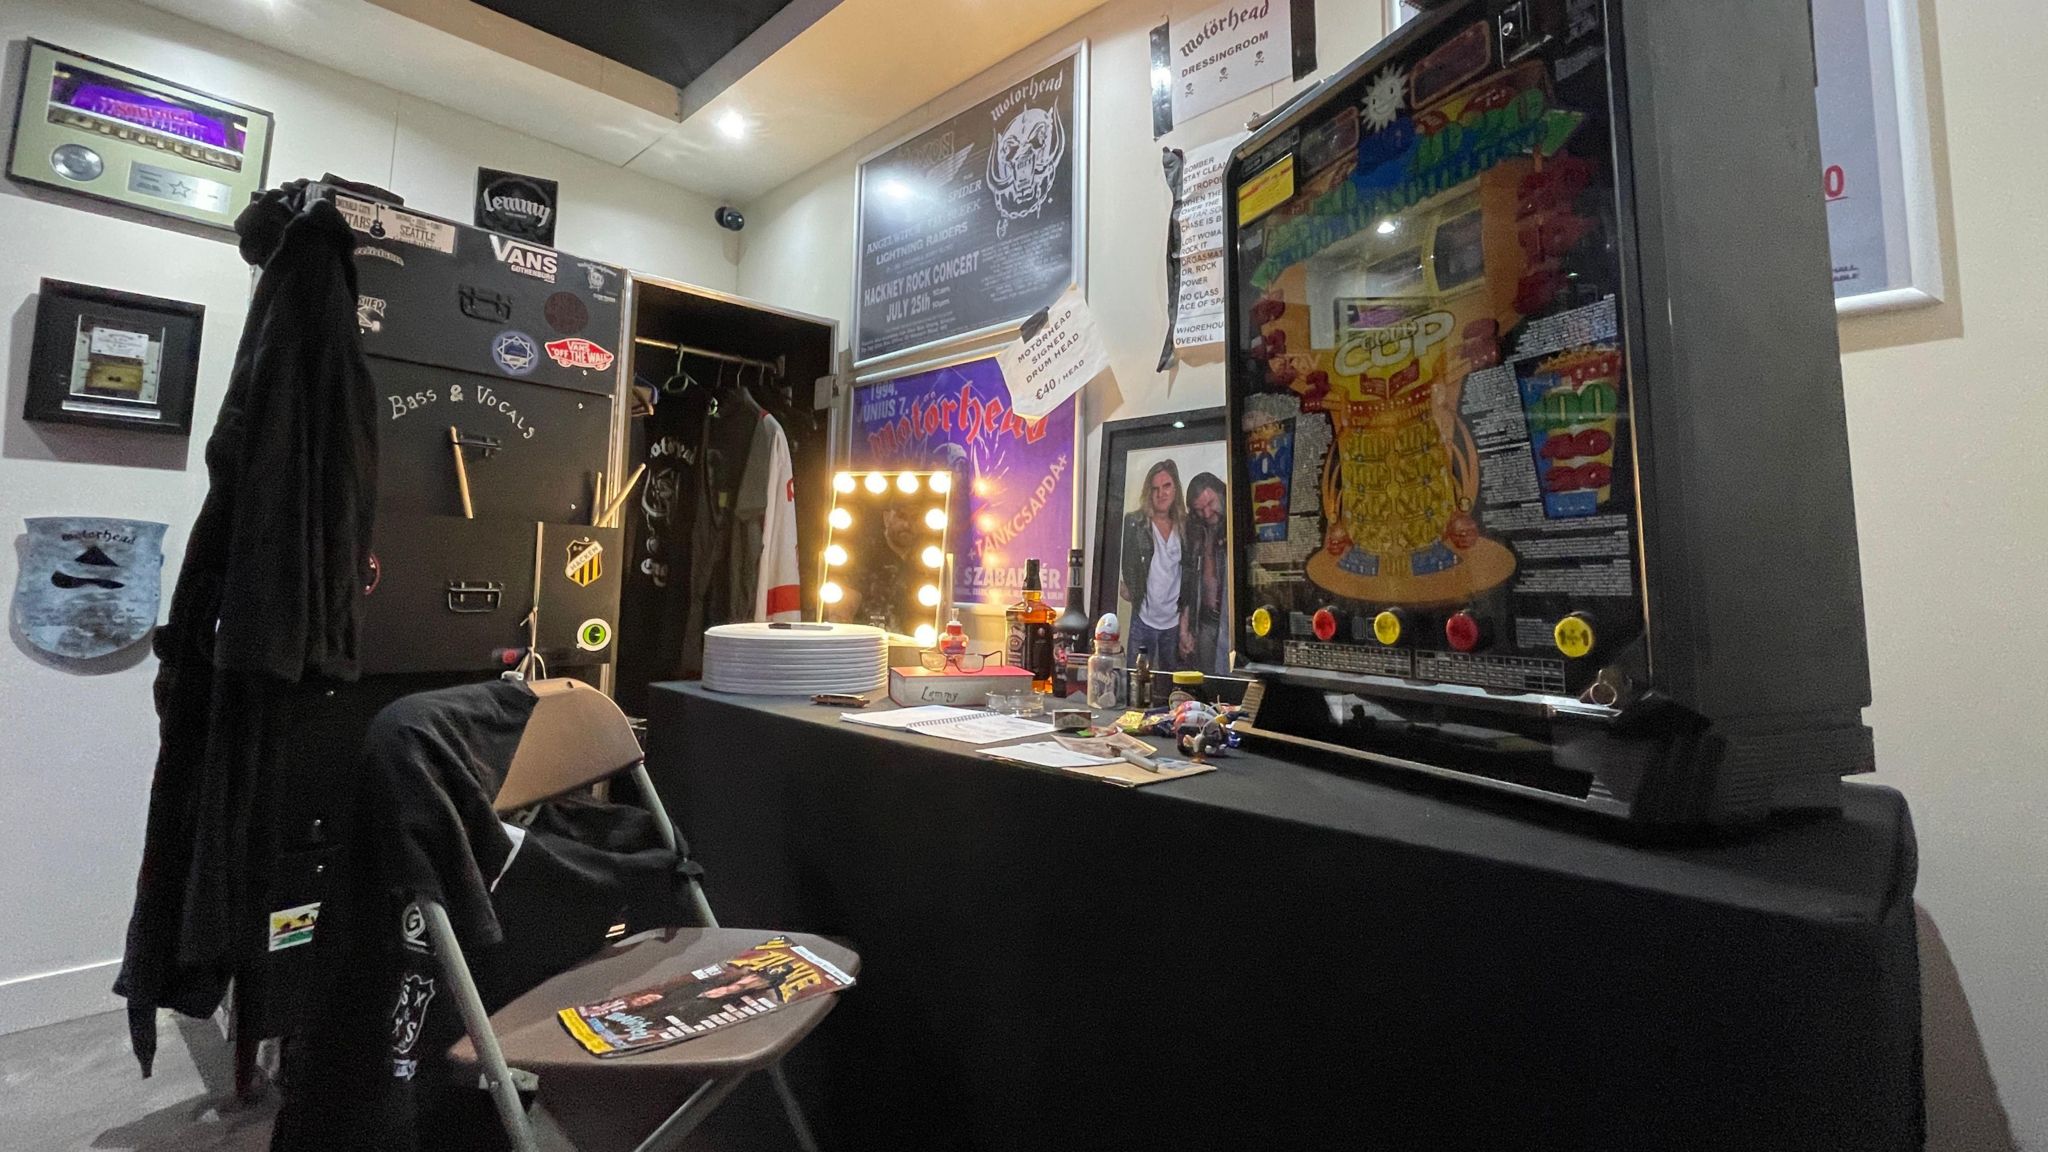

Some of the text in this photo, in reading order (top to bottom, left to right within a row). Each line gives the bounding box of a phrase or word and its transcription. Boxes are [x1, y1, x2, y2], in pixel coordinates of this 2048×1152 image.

[1182, 31, 1269, 77] DRESSINGROOM
[1183, 157, 1214, 174] BOMBER
[1184, 171, 1200, 184] STAY
[1198, 229, 1222, 240] WOMA
[489, 234, 558, 274] VANS
[1196, 261, 1216, 273] ROCK
[864, 277, 904, 307] HACKNEY
[906, 266, 932, 293] ROCK
[933, 250, 980, 284] CONCERT
[1182, 277, 1208, 286] POWER
[1180, 288, 1219, 302] NO CLASS
[886, 298, 909, 322] JULY
[1180, 297, 1224, 311] ACE OF SPA
[1177, 321, 1223, 334] WHOREHOU
[1031, 330, 1066, 364] SIGNED
[1176, 334, 1213, 346] OVERKILL
[1026, 332, 1079, 383] DRUM HEAD
[1062, 359, 1084, 381] HEAD
